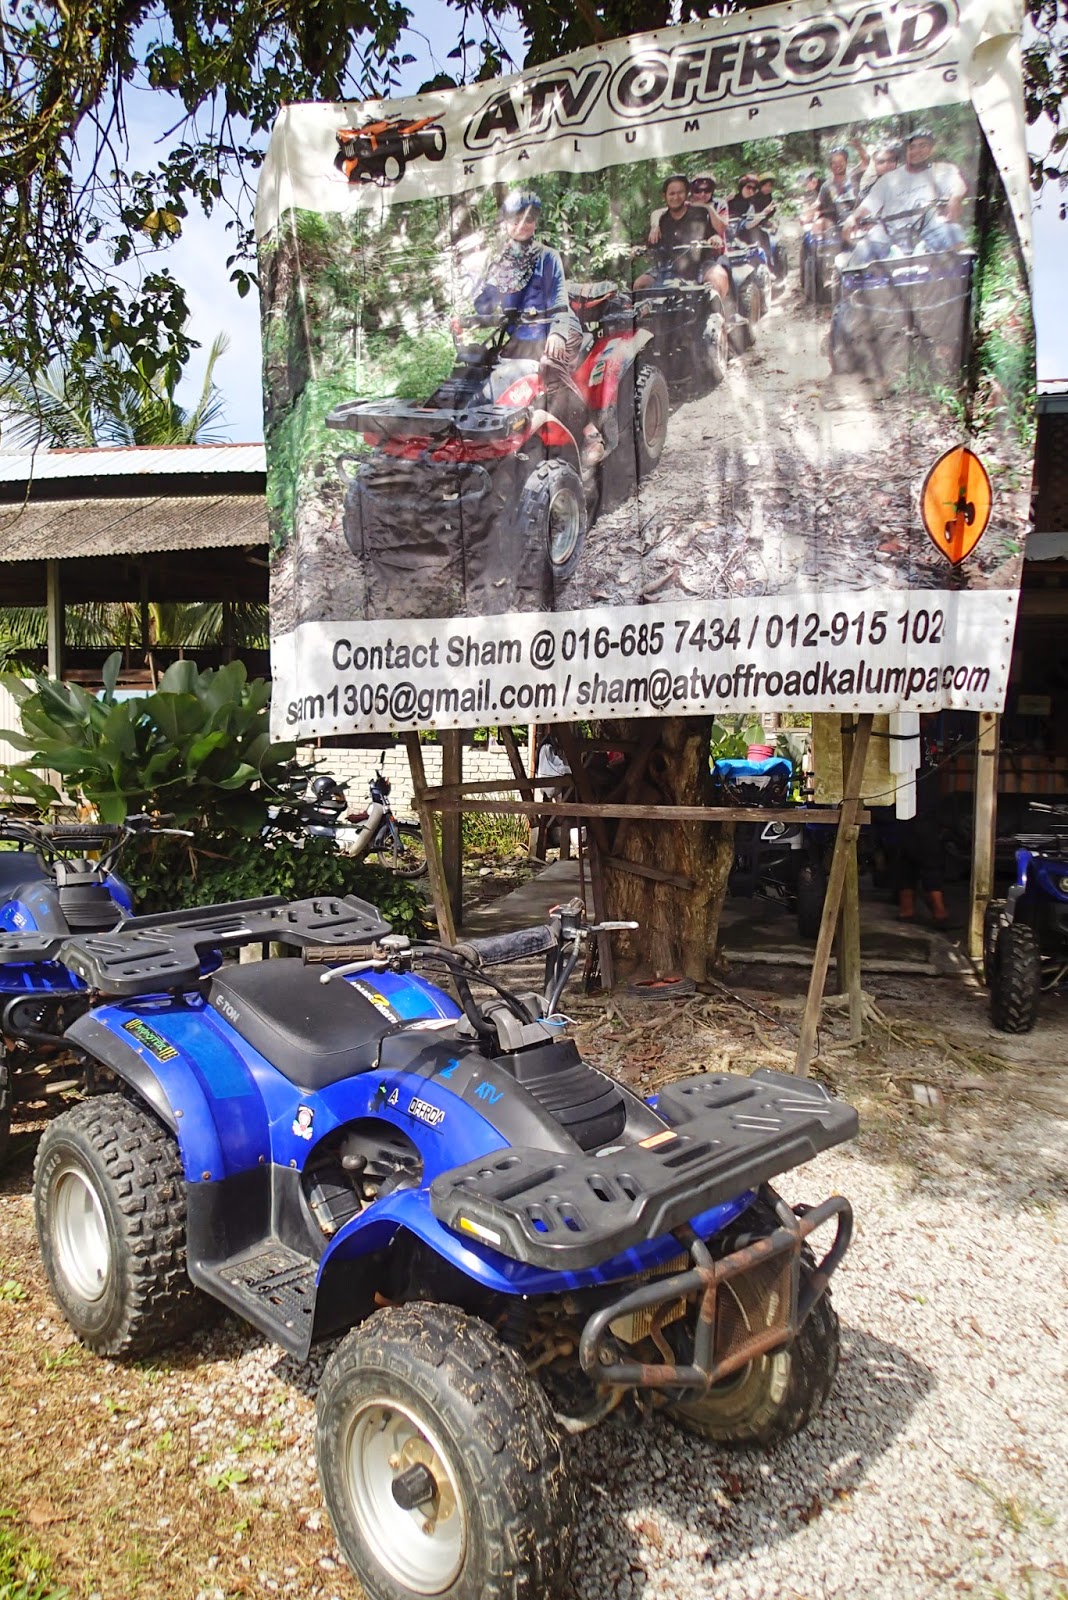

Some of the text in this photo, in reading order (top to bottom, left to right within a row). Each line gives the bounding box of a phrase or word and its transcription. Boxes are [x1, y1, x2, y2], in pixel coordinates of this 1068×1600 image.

[468, 1, 955, 147] ATV OFFROAD
[333, 609, 946, 670] Contact Sham @ 016-685 7434 / 012-915 102
[563, 674, 572, 706] /
[439, 1057, 460, 1080] 2
[473, 1081, 504, 1105] ATV
